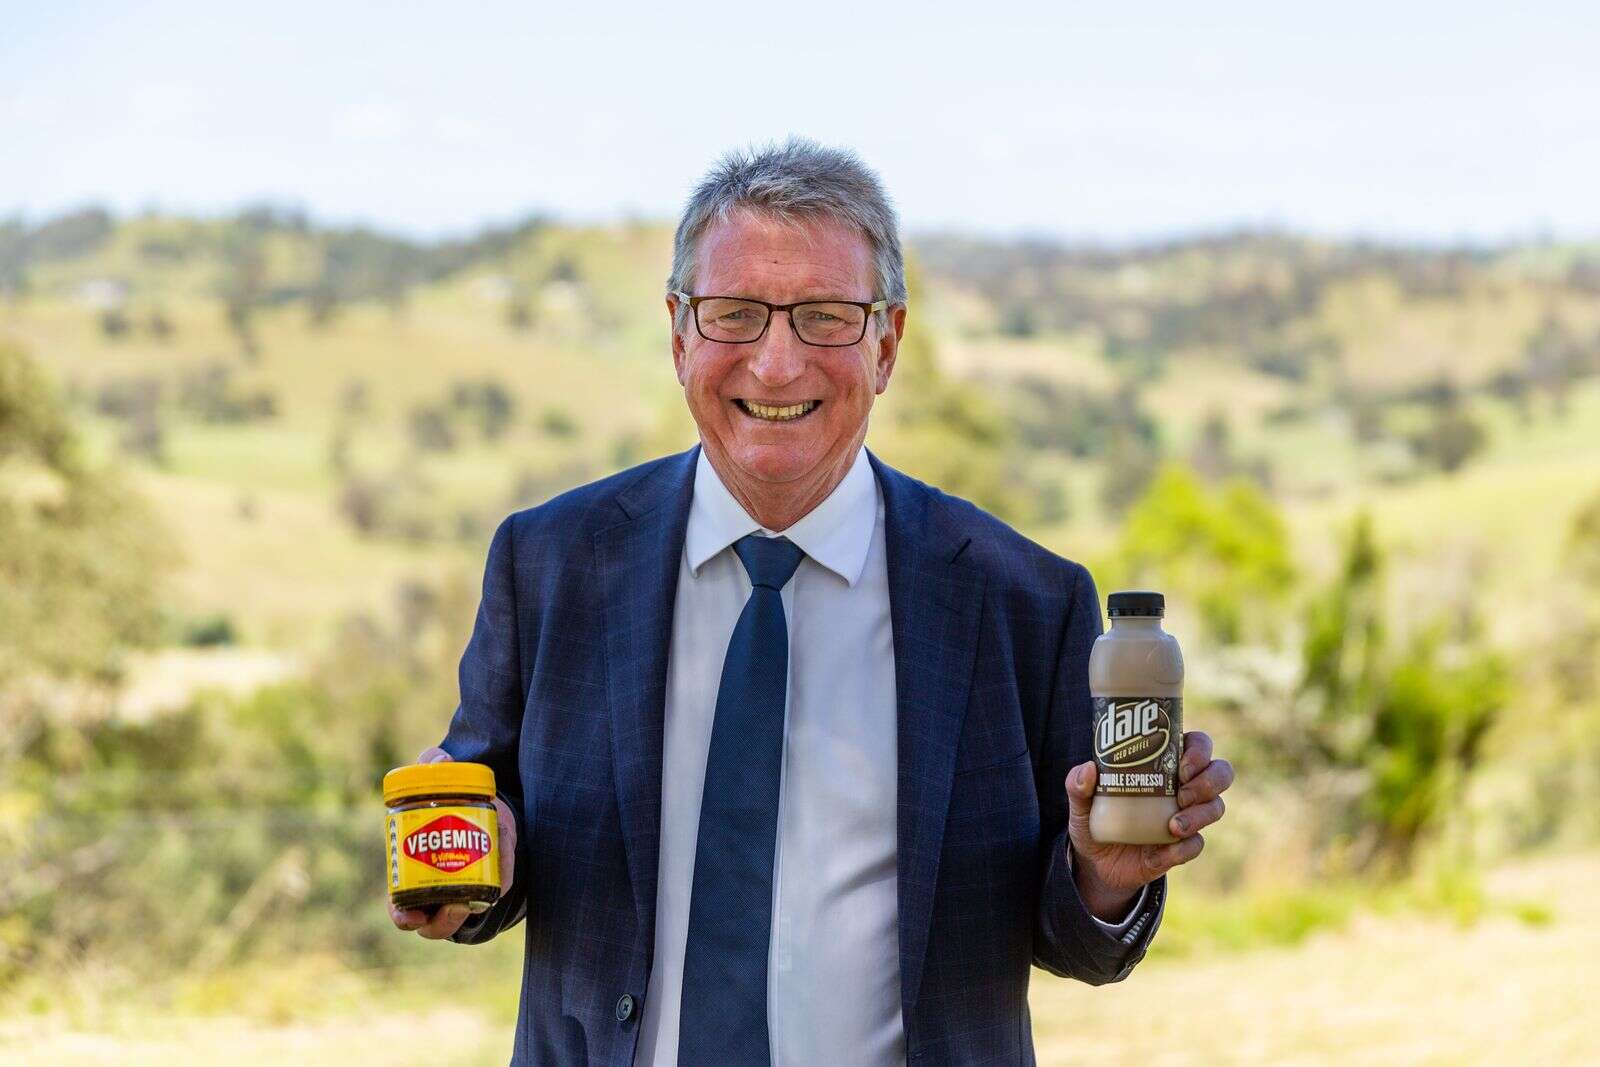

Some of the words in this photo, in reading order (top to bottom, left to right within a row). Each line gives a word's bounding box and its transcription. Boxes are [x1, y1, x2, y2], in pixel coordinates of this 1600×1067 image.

[1101, 699, 1159, 750] dare
[1113, 749, 1127, 762] ICED
[1128, 739, 1150, 755] COFFEE
[1099, 773, 1125, 786] DOUBLE
[1125, 773, 1164, 787] ESPRESSO
[406, 829, 489, 855] VEGEMITE
